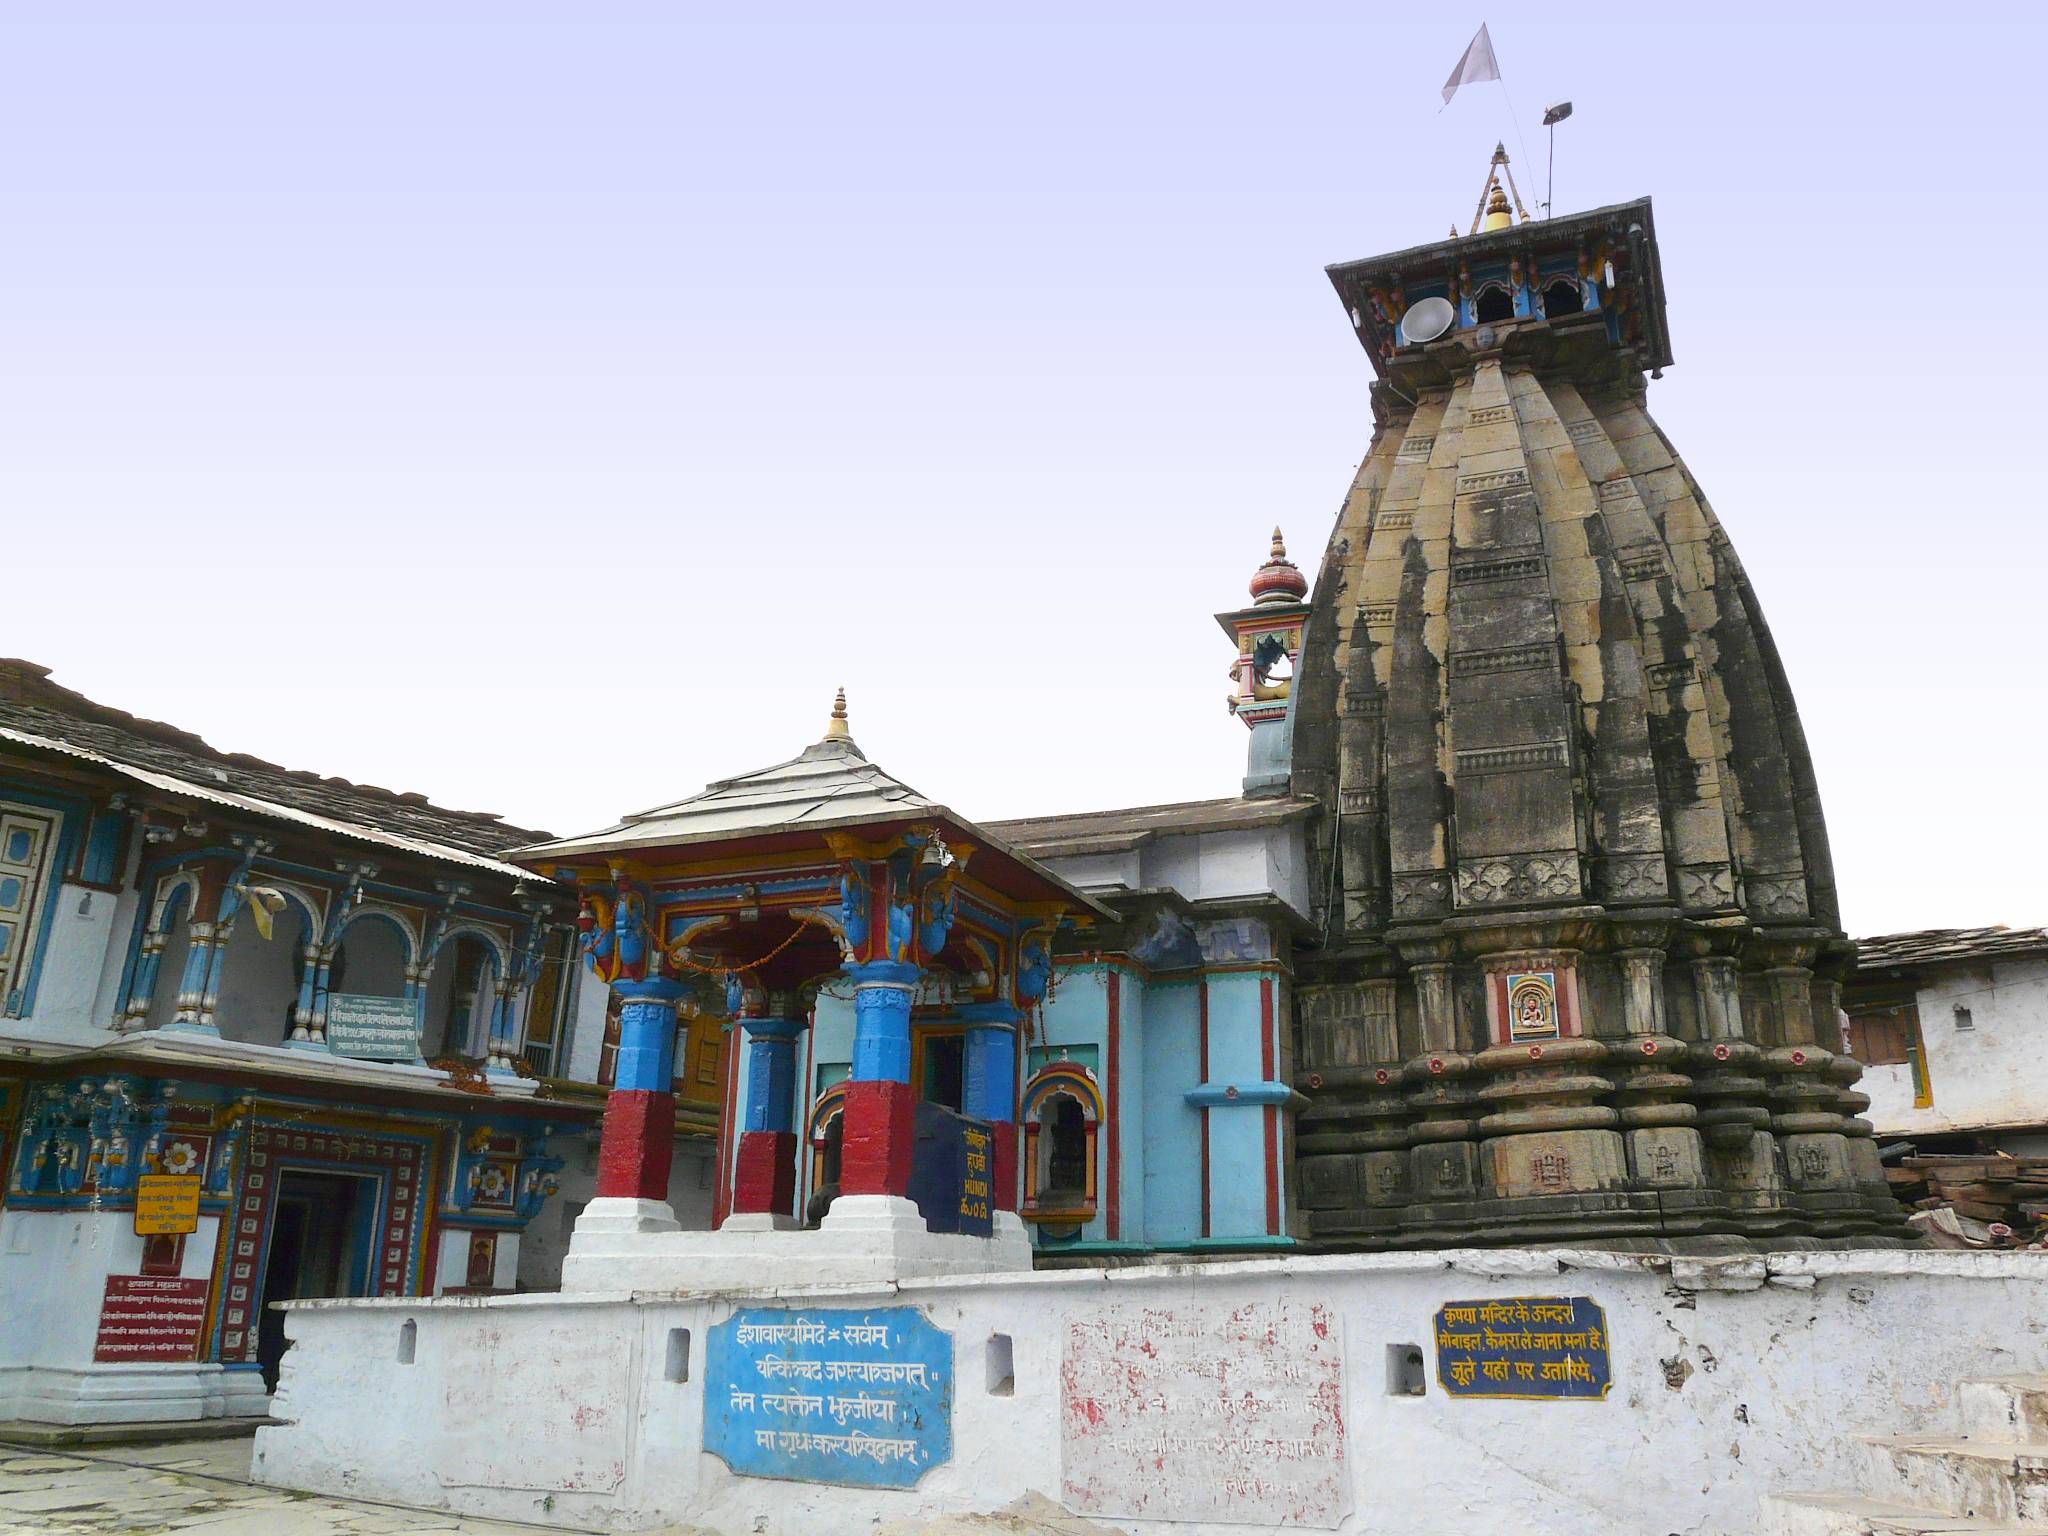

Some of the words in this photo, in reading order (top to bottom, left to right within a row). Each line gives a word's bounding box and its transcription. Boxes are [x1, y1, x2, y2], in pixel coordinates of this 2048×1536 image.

[964, 1179, 989, 1199] HUNDI
[1444, 1306, 1477, 1328] कृपया
[1479, 1301, 1515, 1325] मन्दिर
[1515, 1300, 1532, 1323] के
[1532, 1304, 1574, 1325] अन्दर
[1483, 1326, 1521, 1351] कैमरा
[1521, 1327, 1533, 1351] ले
[1533, 1332, 1562, 1351] जाना
[1564, 1332, 1587, 1350] मना
[1450, 1355, 1477, 1386] जूते
[1514, 1361, 1535, 1381] पर
[729, 1383, 756, 1414] तेन
[754, 1429, 777, 1451] मा
